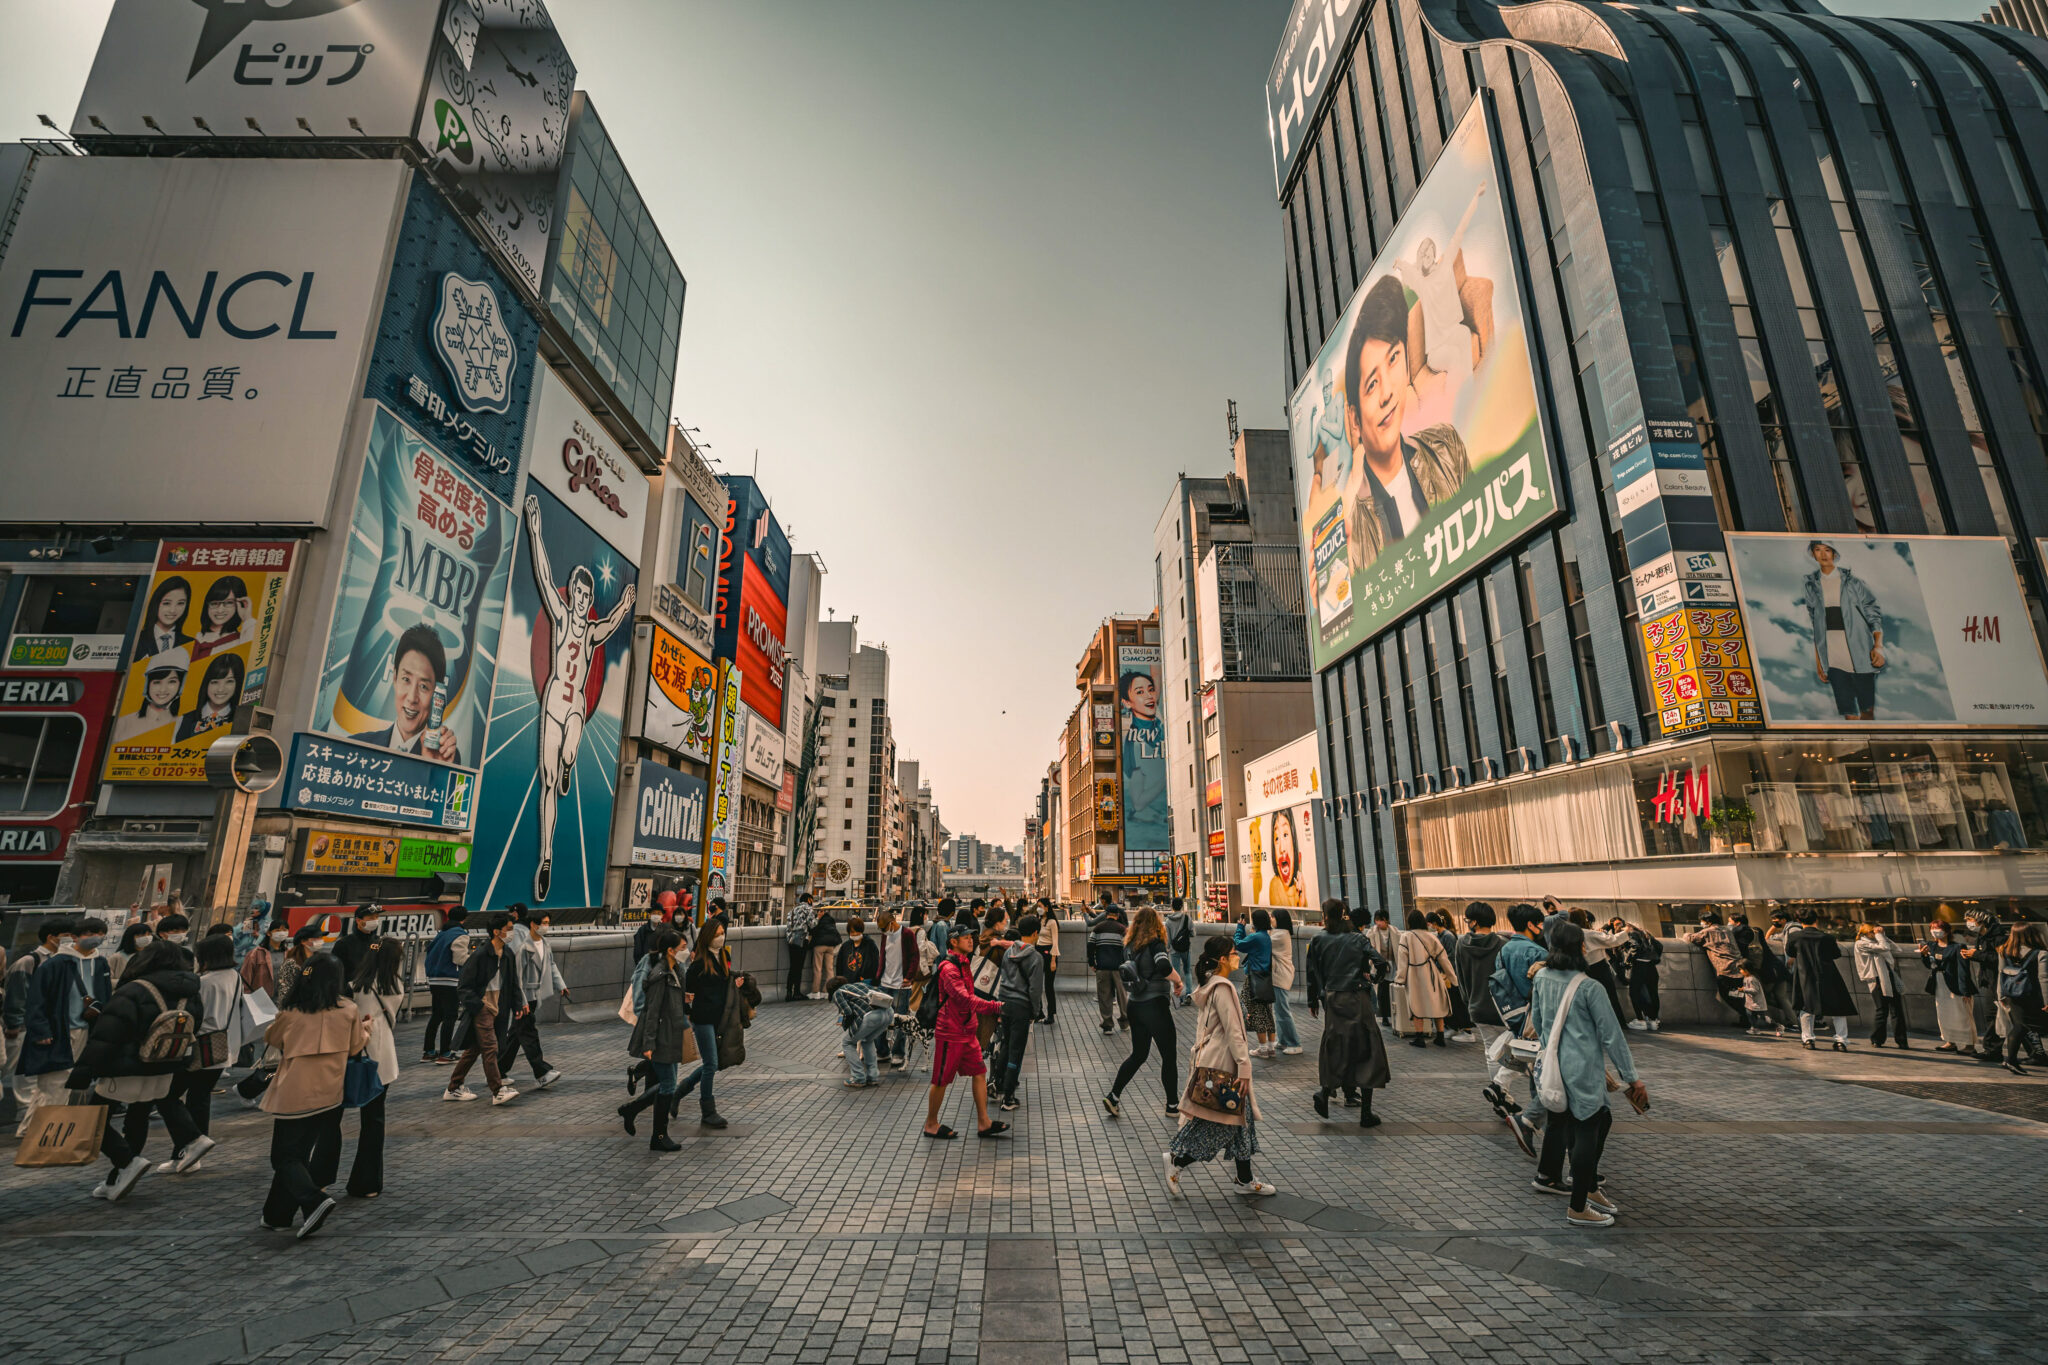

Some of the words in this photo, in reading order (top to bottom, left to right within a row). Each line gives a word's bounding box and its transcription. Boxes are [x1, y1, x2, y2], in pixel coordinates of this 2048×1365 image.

[233, 42, 375, 86] ピップ
[512, 244, 537, 284] 2022
[10, 269, 338, 340] FANCL
[57, 365, 258, 400] 正直品質。
[409, 374, 511, 475] 雪印メグミルク
[1653, 429, 1693, 439] 戎橋ビル
[1612, 434, 1643, 460] 戎橋ビル
[414, 451, 488, 528] 骨密度を
[563, 438, 628, 519] Glico
[417, 490, 475, 551] 高める
[1423, 452, 1540, 577] サロンパス
[192, 548, 286, 566] 住宅情報館
[1316, 526, 1346, 568] サロンパス
[1690, 556, 1712, 569] sta
[396, 526, 477, 618] MBP
[256, 577, 283, 667] 住まいの専門ショップ
[748, 605, 785, 673] PROMISE
[1665, 613, 1688, 671] インター
[1715, 610, 1742, 667] インター
[1961, 616, 2000, 644] H&M
[29, 646, 68, 660] ¥2,800
[562, 640, 582, 704] グリコ
[660, 638, 686, 666] かぜに
[1646, 622, 1677, 706] ネットカフェ
[1691, 610, 1728, 697] ネットカフェ
[655, 654, 687, 694] 改源
[1665, 711, 1678, 719] 24h
[1667, 717, 1679, 725] OPEN
[1712, 702, 1728, 710] 24h
[1128, 728, 1159, 742] new
[306, 743, 393, 773] スキージャンプ
[301, 763, 445, 804] 応援ありがとうございました!
[313, 793, 354, 807] 雪印メグミルク
[1262, 768, 1299, 798] なの花薬局
[1651, 764, 1711, 824] H&M
[640, 781, 703, 843] CHINTAI
[424, 845, 453, 867] ピタットハウス
[347, 914, 436, 936] LTTERIA
[38, 1122, 76, 1147] GAP
